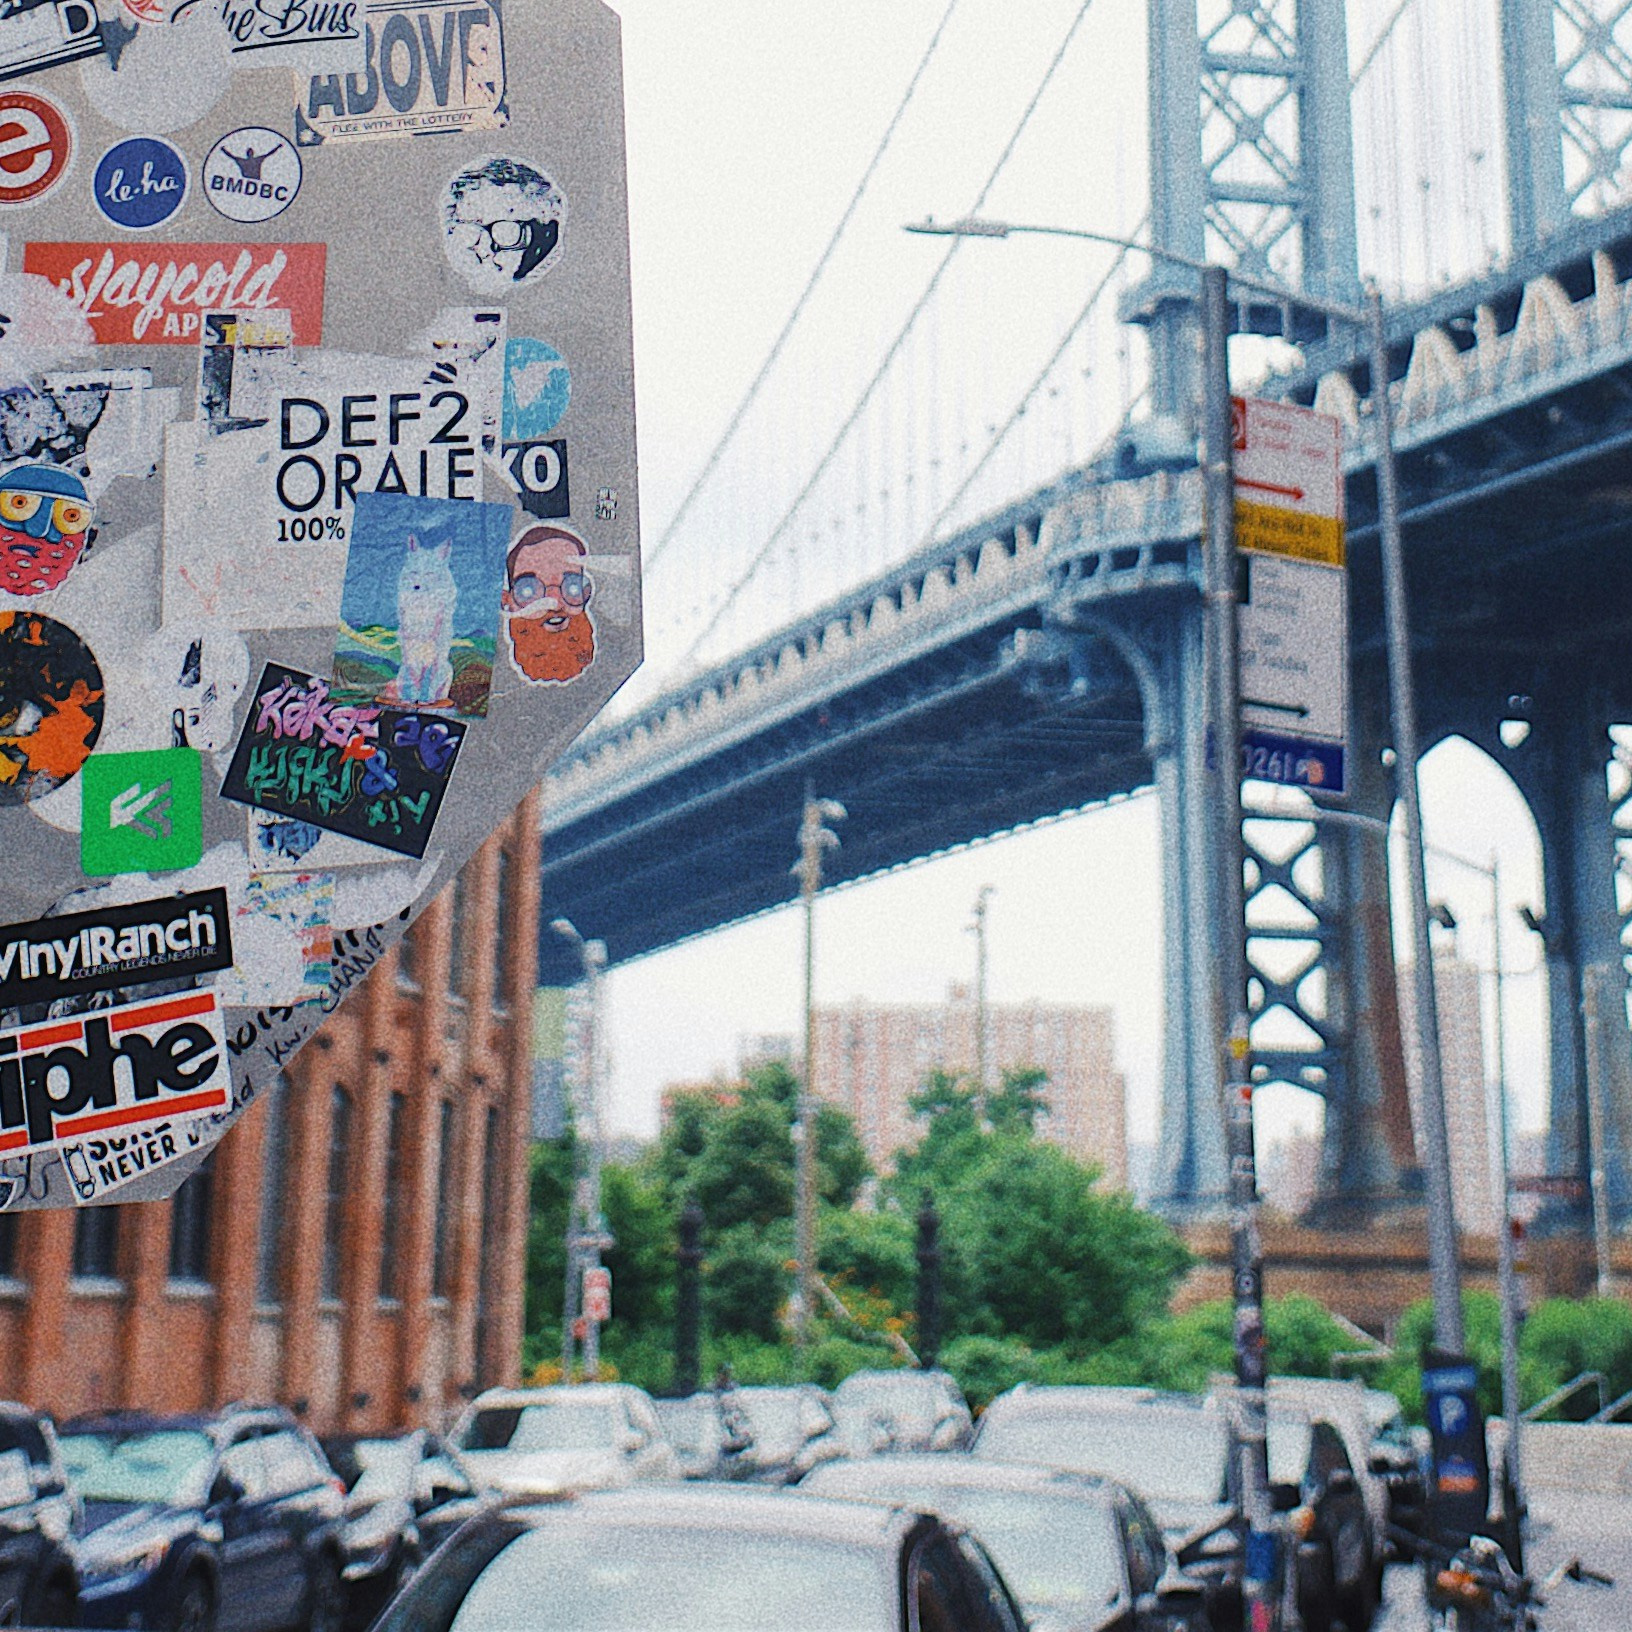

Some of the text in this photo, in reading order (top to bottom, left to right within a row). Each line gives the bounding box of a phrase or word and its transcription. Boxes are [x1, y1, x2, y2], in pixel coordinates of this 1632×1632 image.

[396, 115, 417, 129] THE
[421, 111, 473, 127] LOTTERY
[210, 174, 289, 204] BMDBC
[280, 389, 470, 450] DEF2
[277, 518, 346, 542] 100%
[71, 962, 119, 980] COUNTRY
[167, 947, 201, 963] NEVER
[98, 1133, 178, 1186] NEVER
